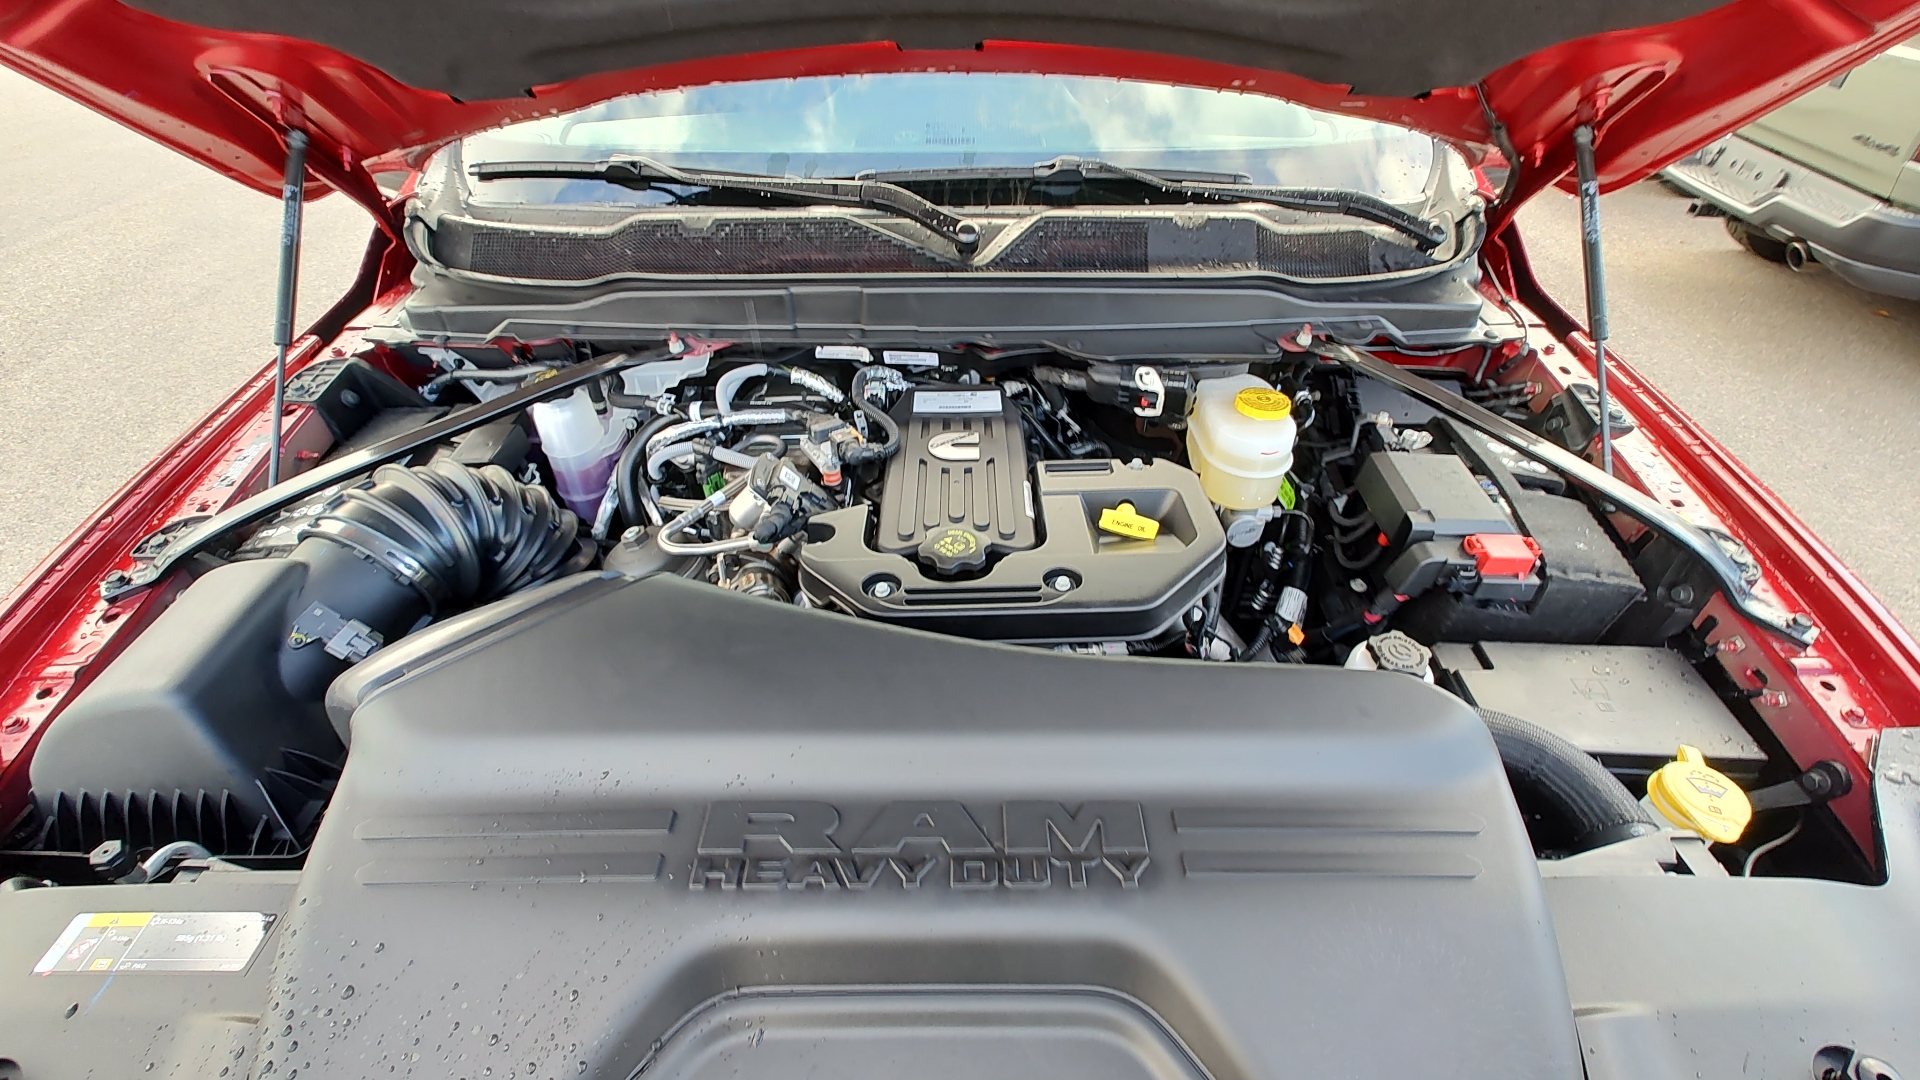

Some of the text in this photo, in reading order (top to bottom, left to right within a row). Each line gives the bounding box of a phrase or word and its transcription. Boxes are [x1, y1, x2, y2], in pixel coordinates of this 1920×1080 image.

[1111, 519, 1146, 533] ENGINE OIL
[696, 799, 1150, 854] RAM
[688, 856, 1151, 891] HEAVY DUTY
